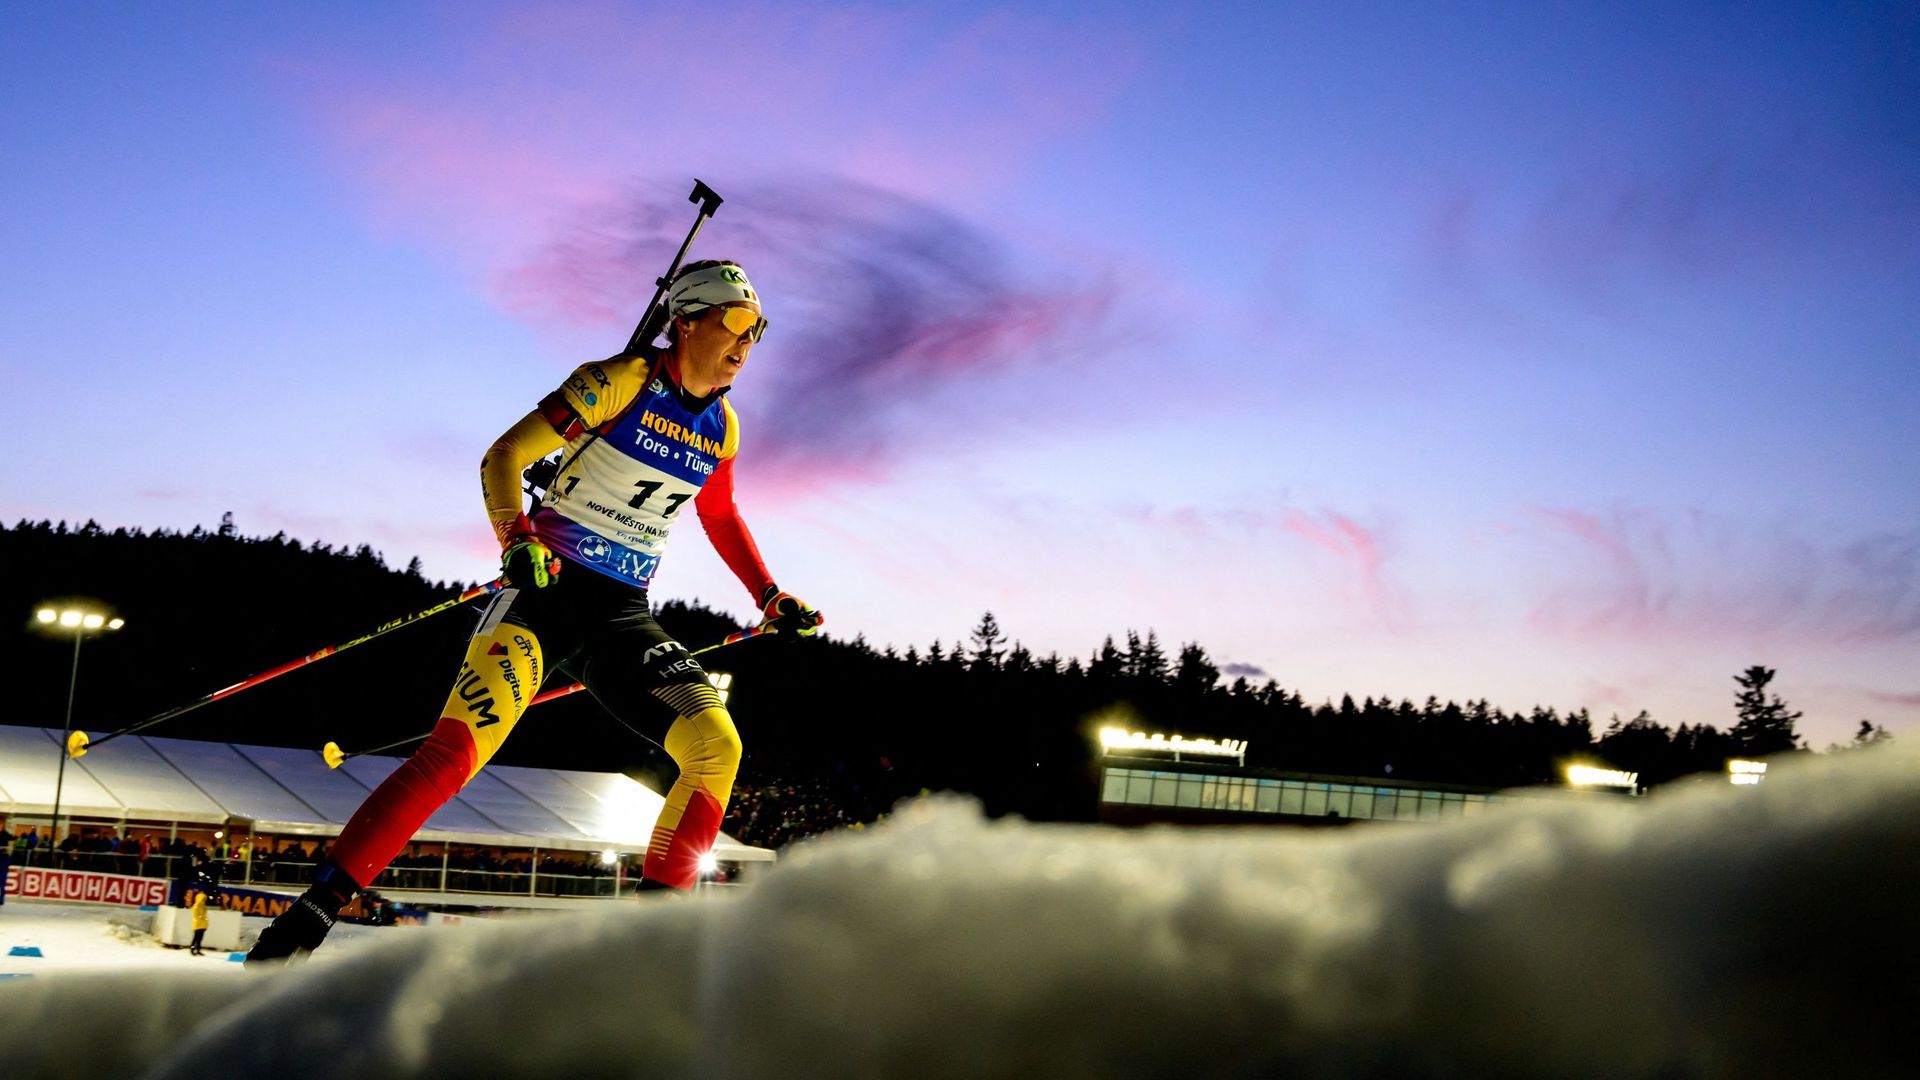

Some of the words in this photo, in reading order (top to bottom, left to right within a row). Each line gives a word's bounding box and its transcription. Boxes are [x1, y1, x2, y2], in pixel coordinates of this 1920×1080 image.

[640, 409, 722, 459] HÖRMANN
[635, 429, 669, 457] Tore
[685, 451, 713, 475] Türen
[586, 501, 616, 518] NOVÉ
[614, 513, 645, 531] MĚSTO
[644, 526, 657, 536] NA
[530, 657, 538, 687] RENT
[658, 658, 707, 678] HEC
[25, 873, 165, 904] BAUHAUS
